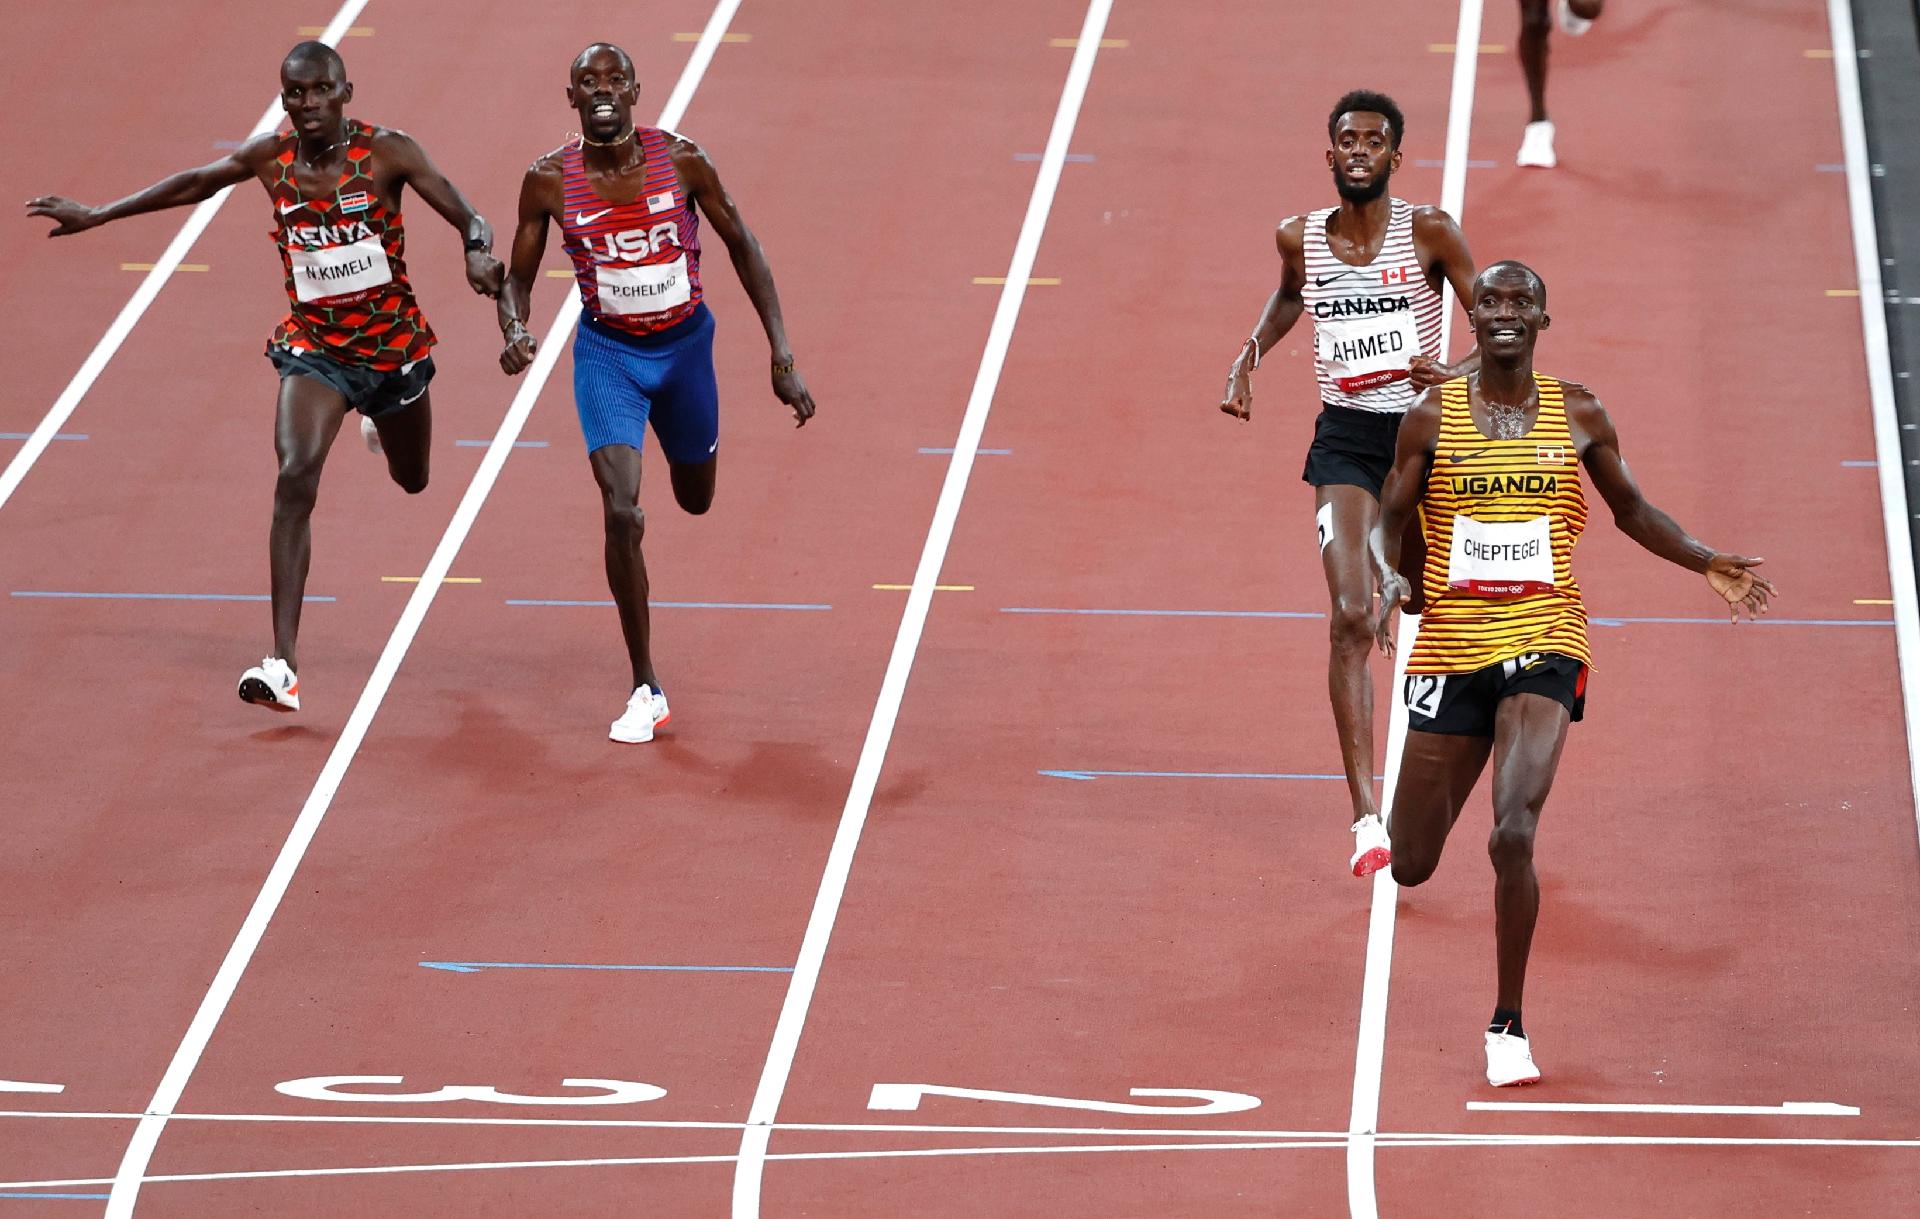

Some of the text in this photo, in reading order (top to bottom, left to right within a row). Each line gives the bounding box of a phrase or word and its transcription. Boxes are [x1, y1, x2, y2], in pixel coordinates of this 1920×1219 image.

[285, 221, 374, 246] KENYA
[582, 221, 680, 262] USA
[306, 256, 373, 281] N.KIMELI
[612, 275, 676, 298] P.CHELIMO
[1315, 296, 1410, 319] CANADA
[1333, 330, 1403, 362] AHMED
[1450, 475, 1558, 496] UGANDA
[1464, 538, 1540, 561] CHEPTEGEI
[867, 1083, 1262, 1115] 2
